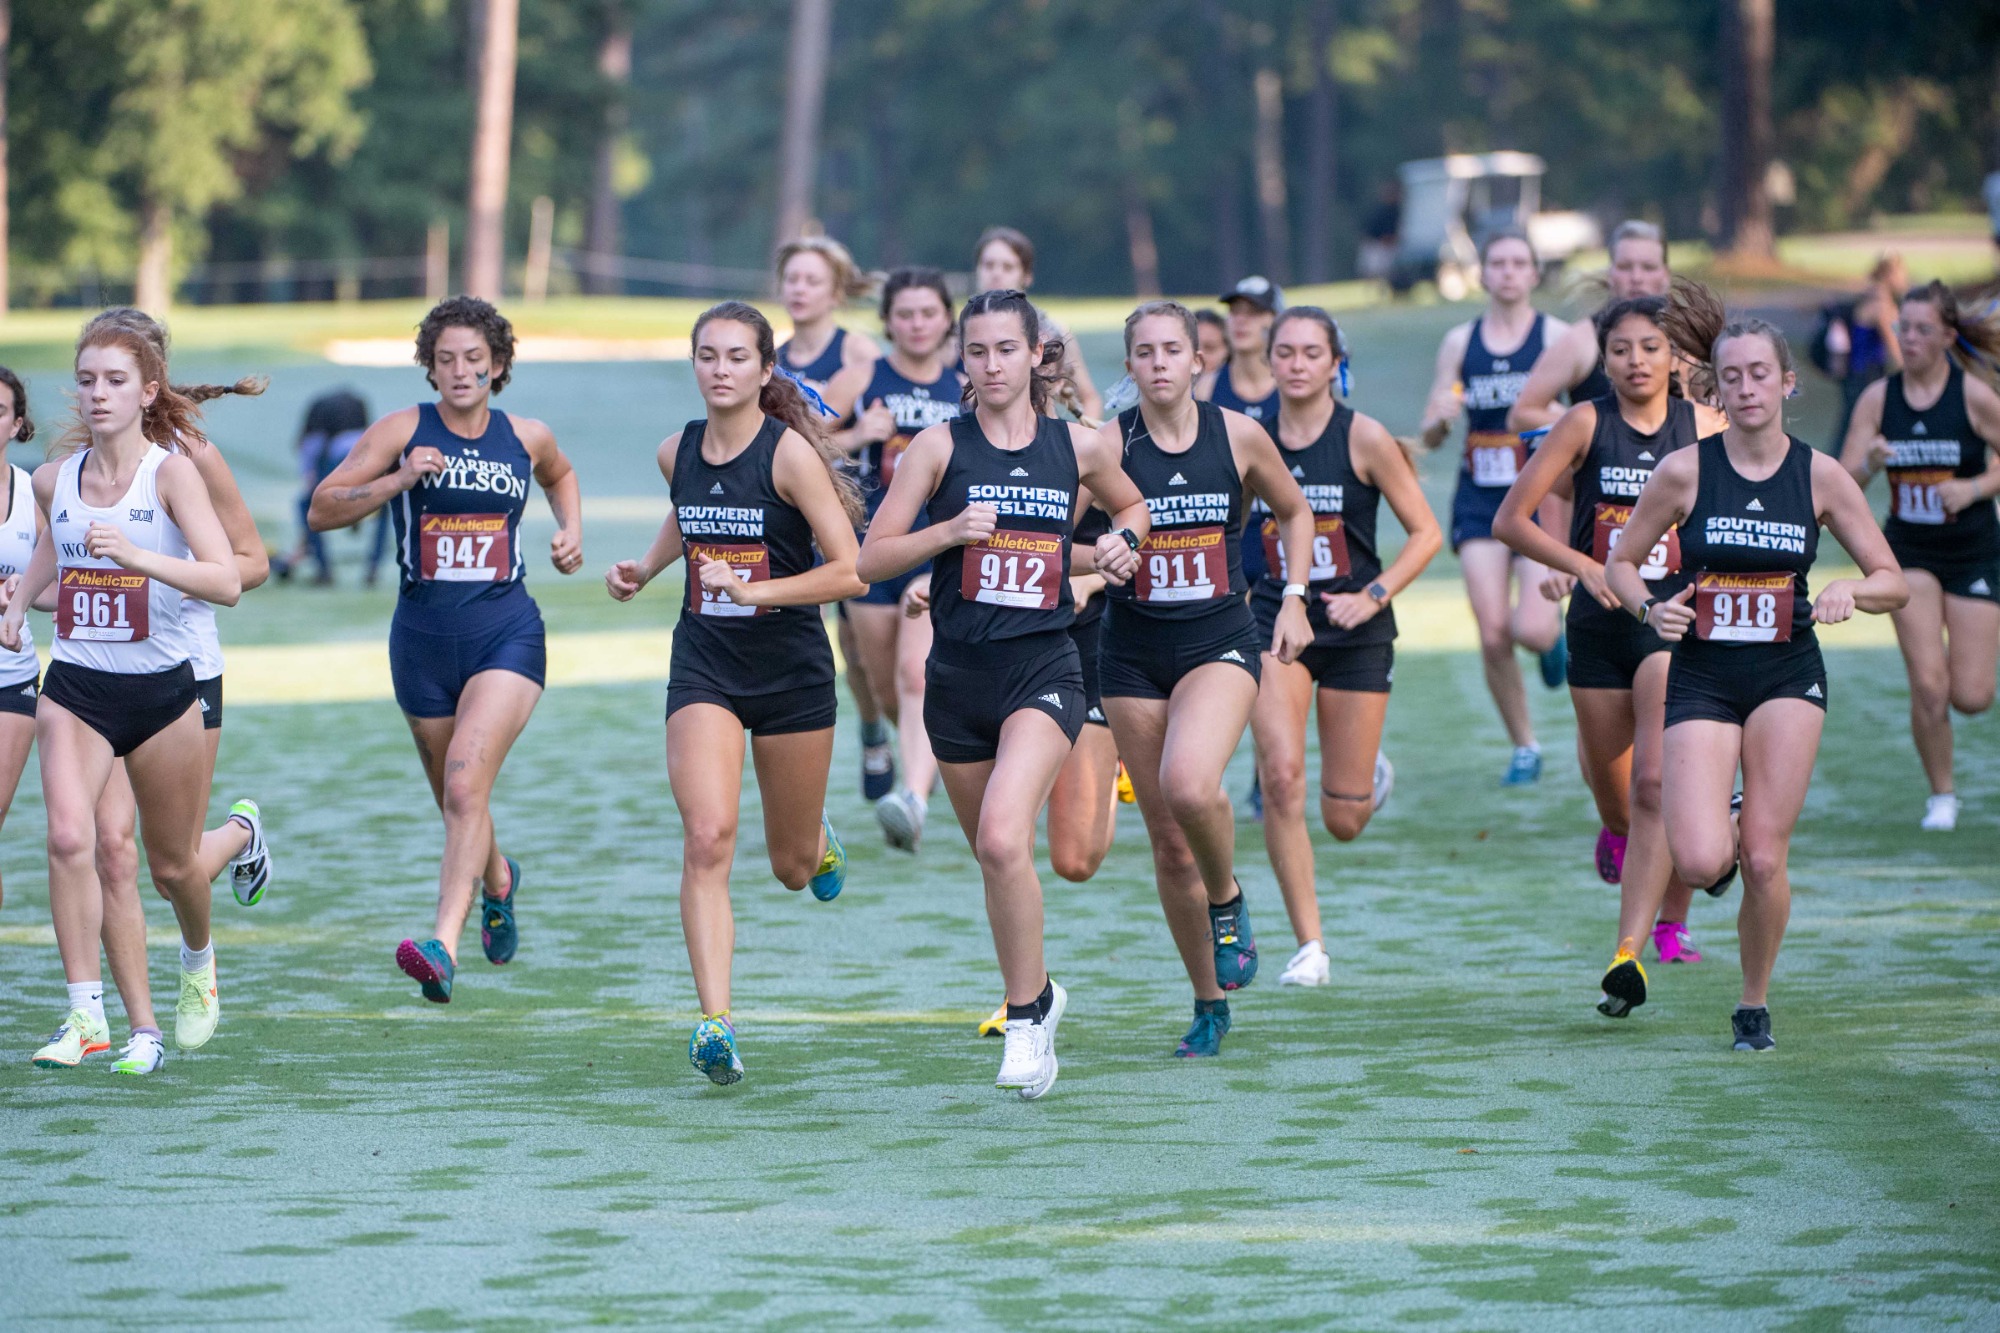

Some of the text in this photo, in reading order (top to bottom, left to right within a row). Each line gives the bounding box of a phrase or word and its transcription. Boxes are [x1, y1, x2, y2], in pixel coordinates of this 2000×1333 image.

[443, 455, 513, 476] WARREN
[1600, 466, 1653, 482] SOUT
[421, 468, 526, 500] WILSON
[1299, 484, 1344, 498] HERN
[1600, 480, 1646, 496] WES
[967, 484, 1070, 505] SOUTHERN
[1145, 493, 1229, 512] OUTHERN
[678, 506, 764, 522] SOUTHERN
[968, 500, 1069, 521] ESLEYAN
[1150, 508, 1229, 526] ESLEYAN
[423, 517, 483, 532] Athletic
[678, 520, 764, 537] WESLEYAN
[1706, 516, 1806, 539] SOUTHERN
[61, 542, 92, 559] WO
[966, 533, 1036, 550] thletic
[1705, 531, 1805, 554] WESLEYAN
[436, 535, 494, 568] 947
[62, 570, 121, 587] Athletic
[980, 554, 1045, 593] 912
[1150, 552, 1211, 588] 911
[1699, 574, 1764, 589] Athletic
[73, 591, 130, 628] 961
[1713, 593, 1776, 628] 918
